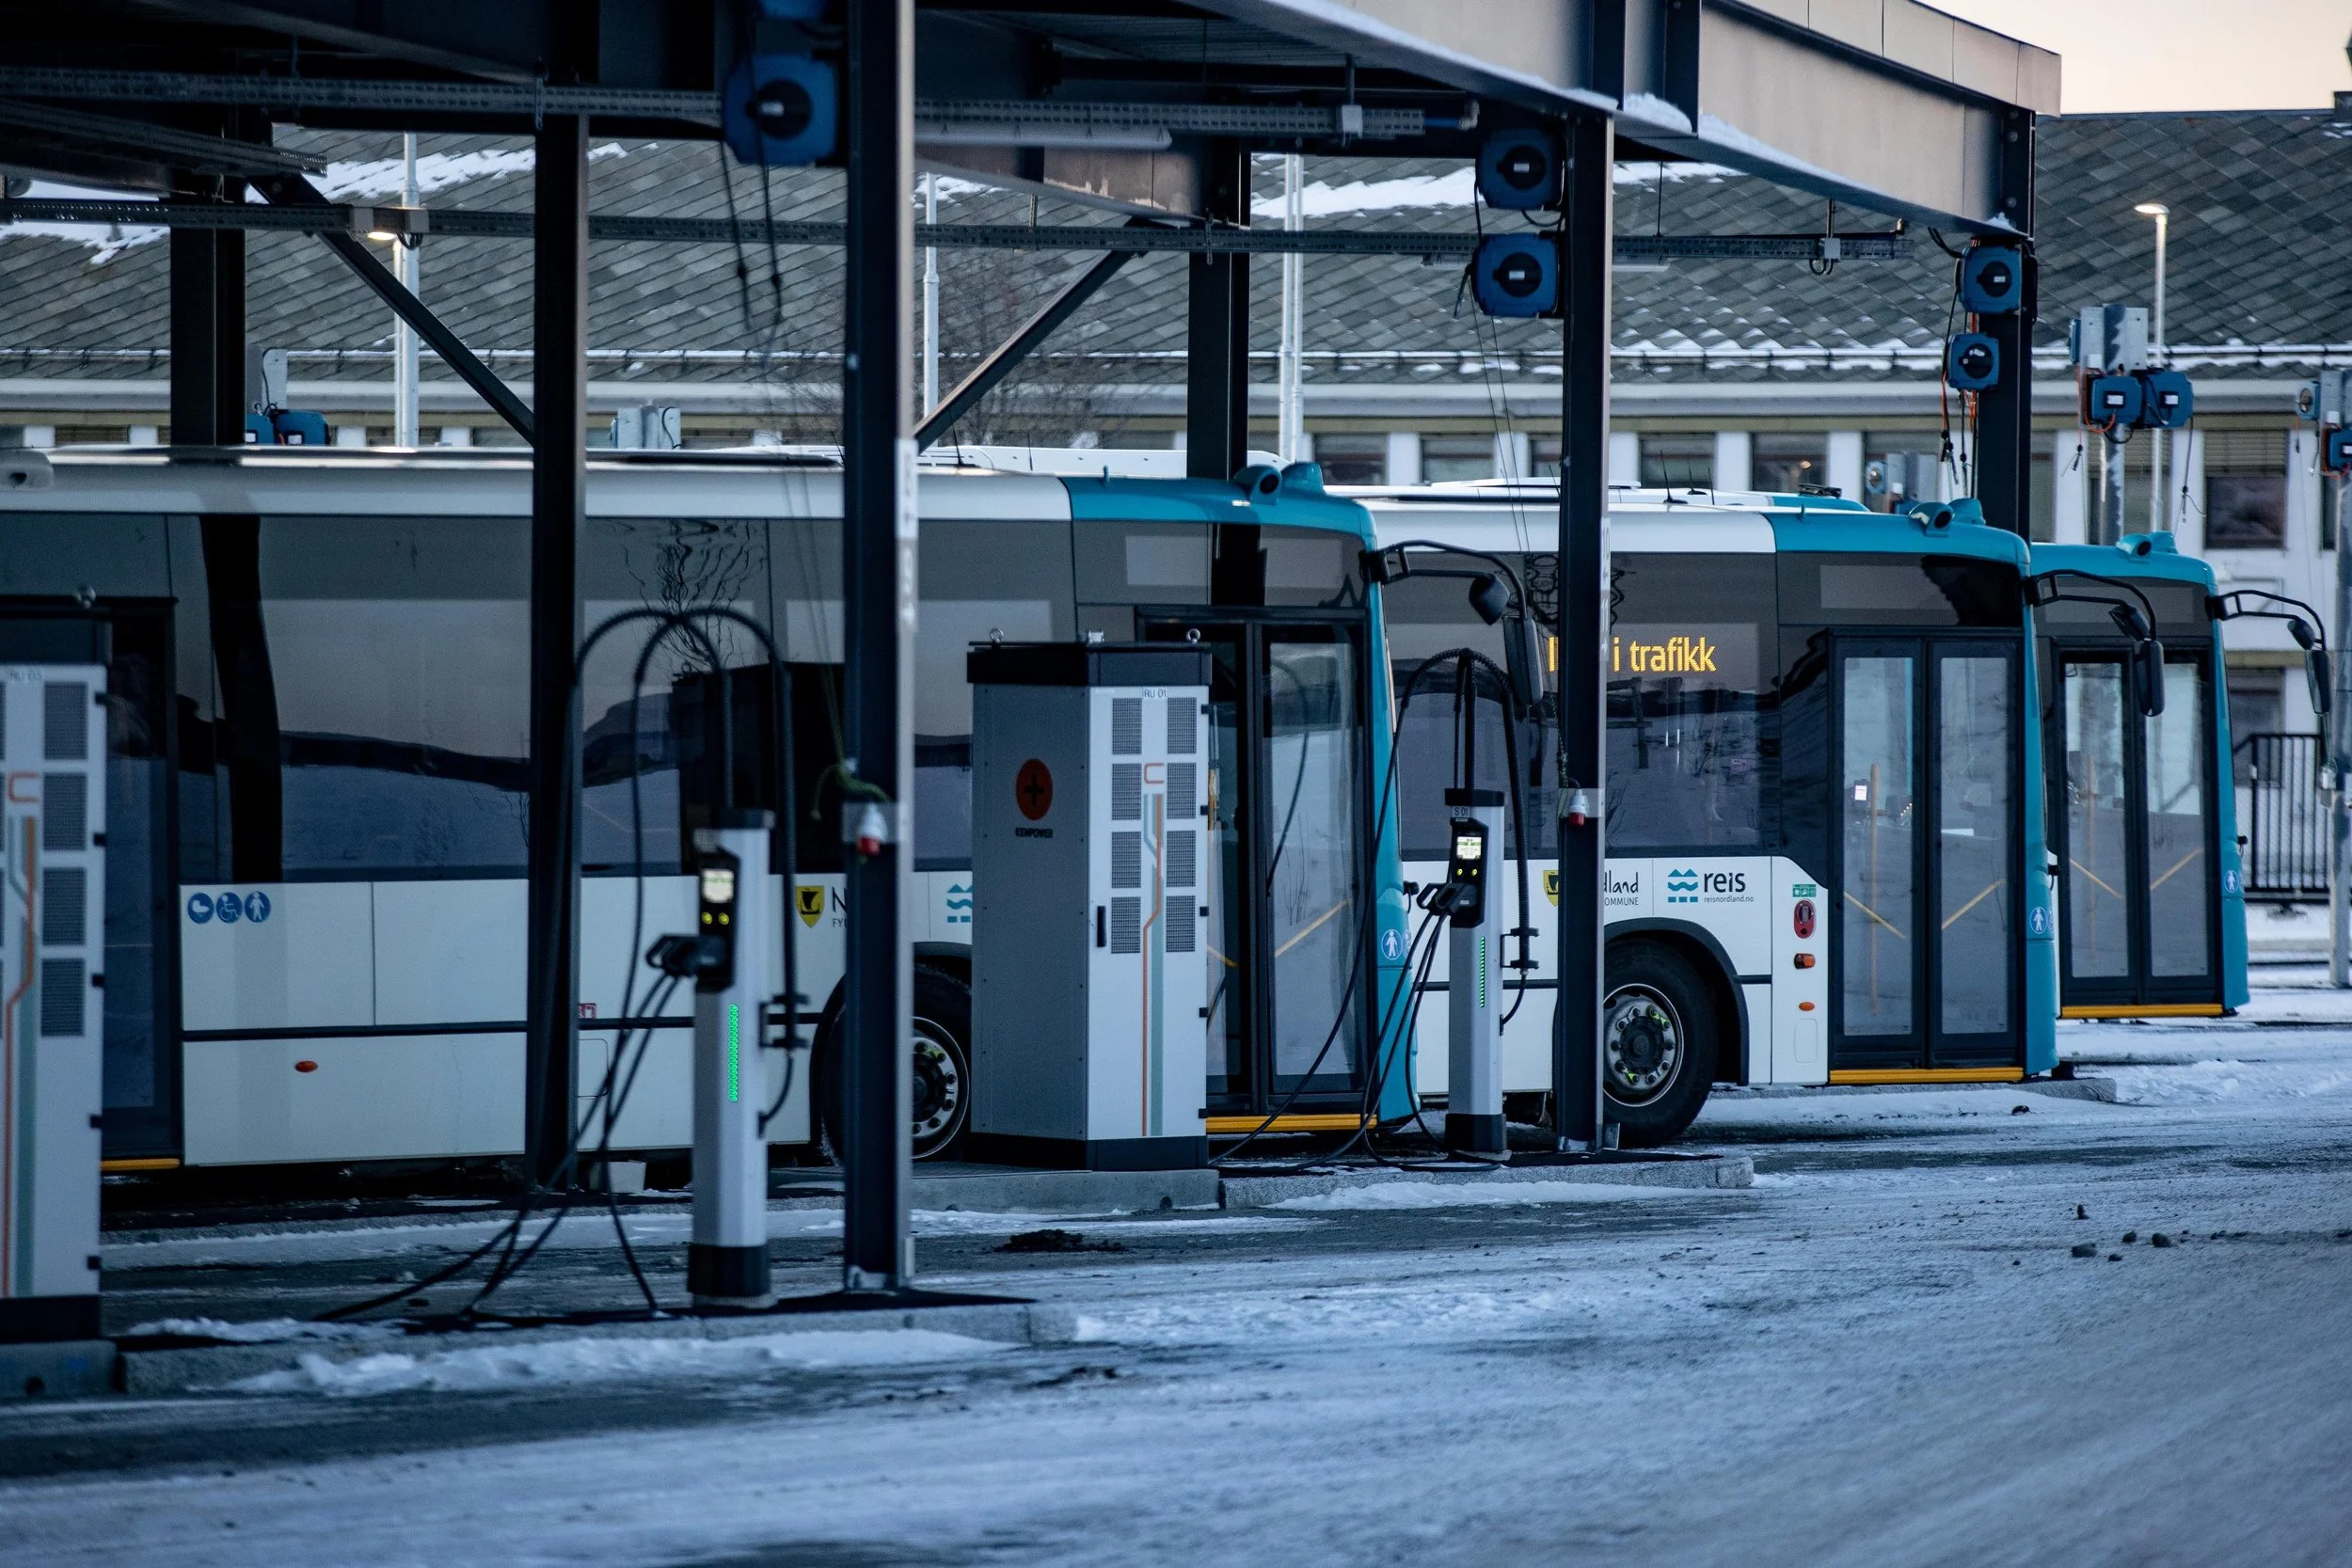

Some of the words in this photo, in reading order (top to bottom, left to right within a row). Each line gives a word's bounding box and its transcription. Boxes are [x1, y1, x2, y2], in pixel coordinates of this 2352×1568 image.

[1613, 637, 1620, 672] i
[1629, 637, 1717, 672] trafikk
[1144, 689, 1155, 698] RU
[1158, 689, 1167, 698] 01
[1454, 807, 1460, 816] S
[1461, 807, 1469, 816] 01
[1603, 870, 1639, 894] dland
[1704, 872, 1746, 893] reis
[1604, 897, 1639, 906] OMMUNE
[1704, 895, 1755, 903] reisnordland.no
